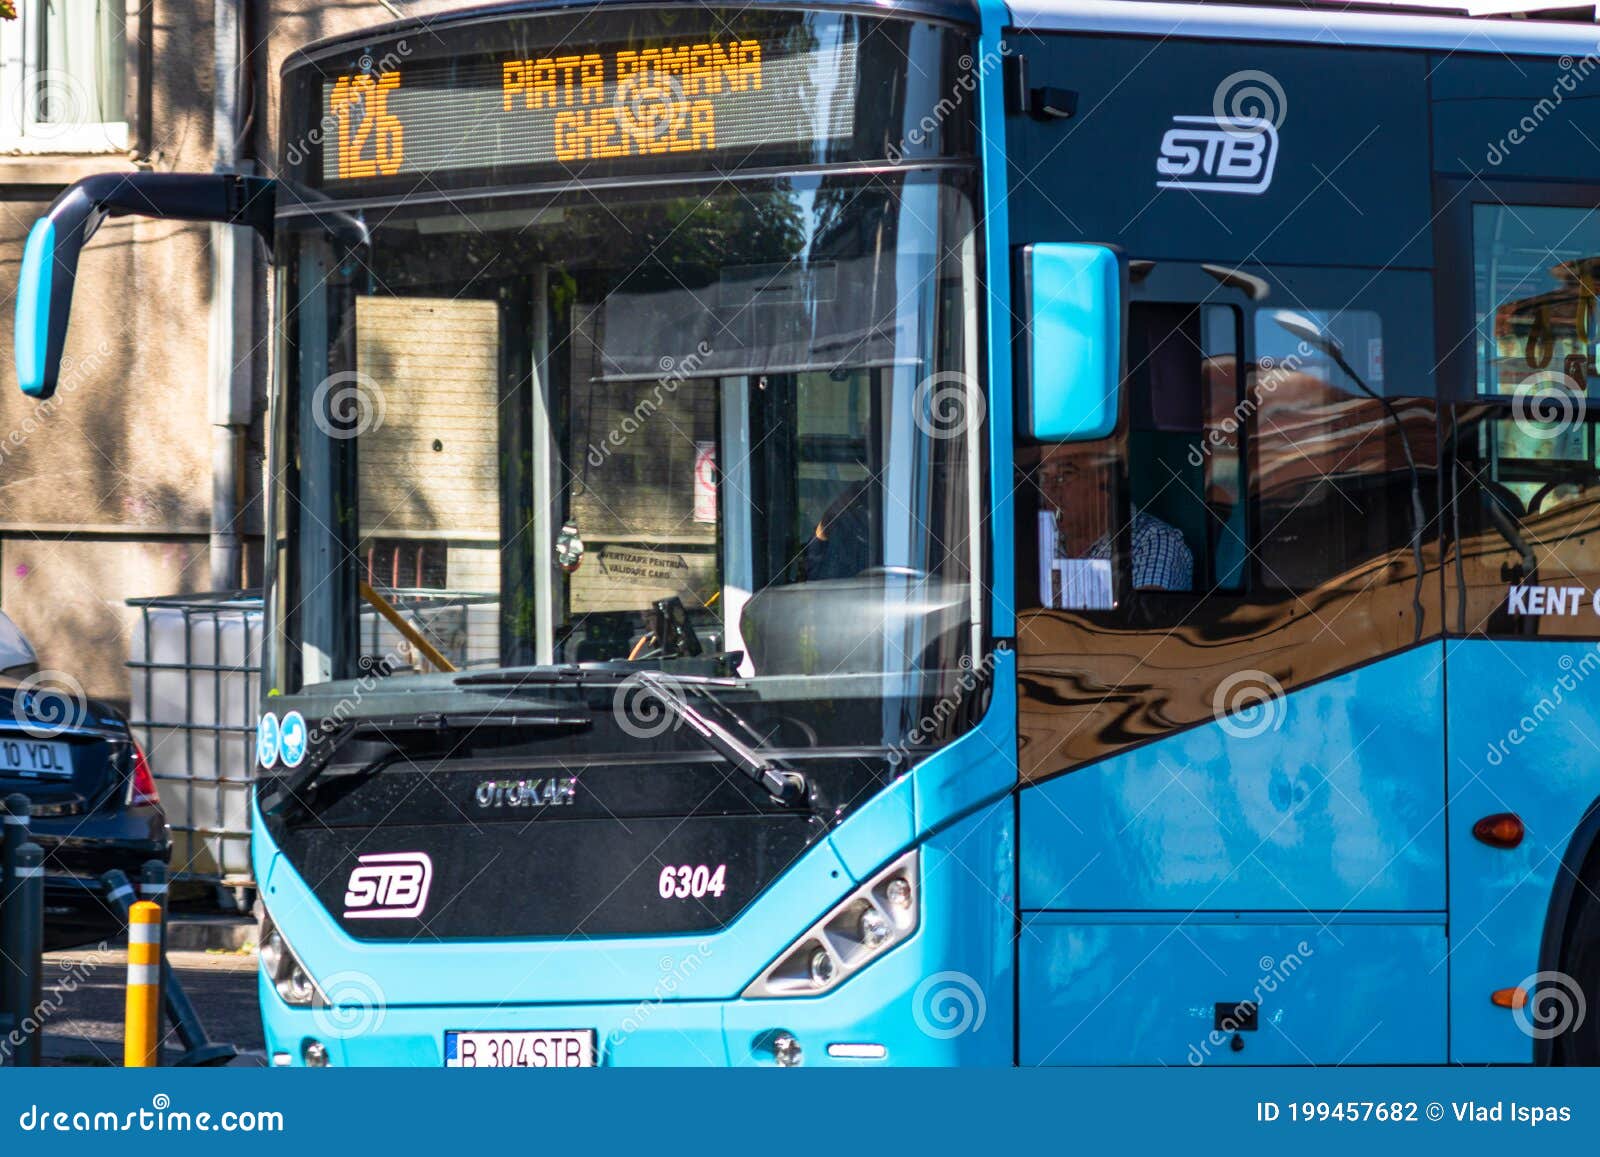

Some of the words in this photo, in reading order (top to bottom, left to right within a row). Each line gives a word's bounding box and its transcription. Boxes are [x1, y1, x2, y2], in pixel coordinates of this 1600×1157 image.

[503, 54, 604, 111] PIATA
[616, 40, 762, 101] ROMANA
[329, 72, 403, 178] 126
[555, 100, 717, 160] GHENCEA
[1156, 127, 1269, 180] STB
[1507, 585, 1585, 616] KENT
[344, 863, 424, 908] STB
[658, 864, 727, 899] 6304
[462, 1039, 477, 1067] B
[488, 1038, 581, 1067] 304STB
